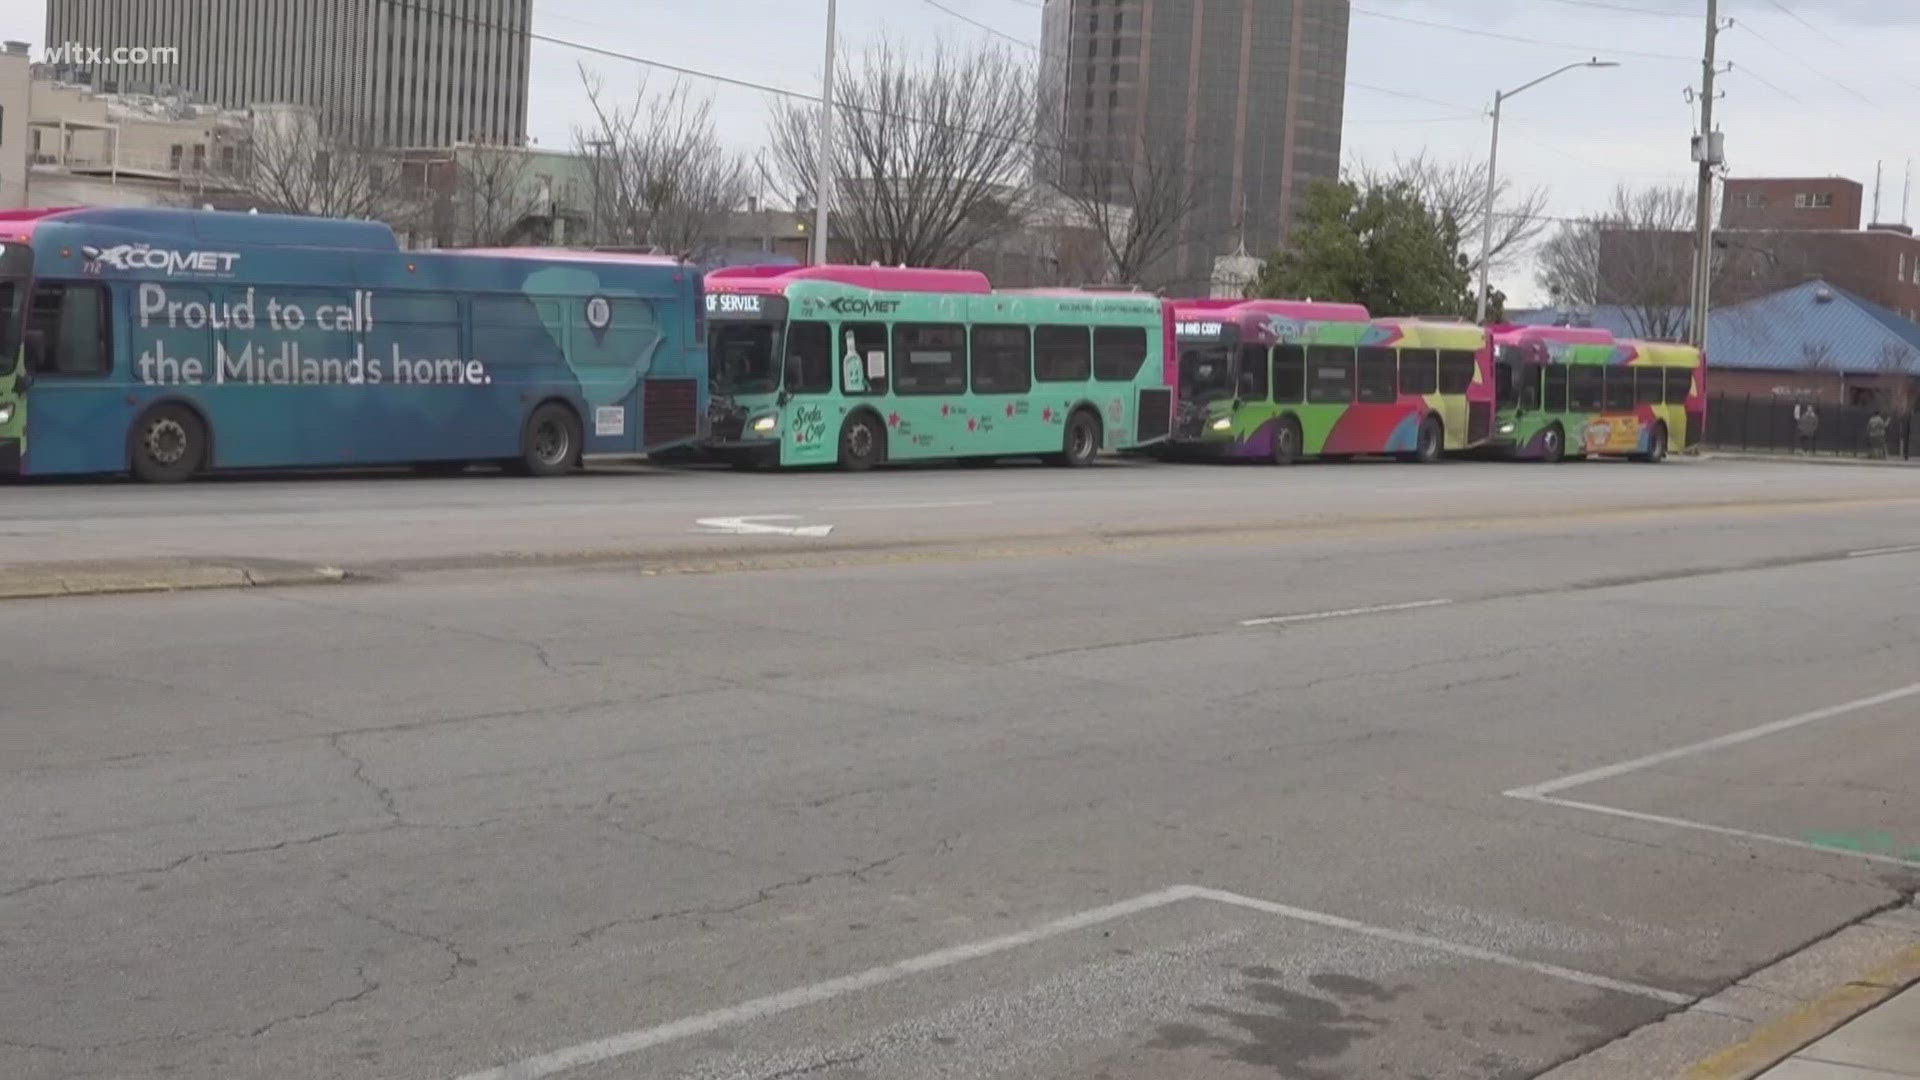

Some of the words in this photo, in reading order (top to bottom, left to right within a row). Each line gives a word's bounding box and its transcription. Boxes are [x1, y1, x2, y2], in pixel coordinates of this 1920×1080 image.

[126, 249, 241, 276] COMET
[139, 283, 255, 330] Proud
[266, 297, 305, 331] to
[316, 288, 373, 332] call
[705, 294, 718, 312] OF
[720, 294, 761, 313] SERVICE
[842, 297, 901, 317] COMET
[1185, 322, 1200, 335] AND
[1201, 322, 1222, 336] CODY
[138, 340, 203, 386] the
[216, 340, 382, 386] Midlands
[392, 342, 492, 386] home.
[792, 403, 823, 432] Soda
